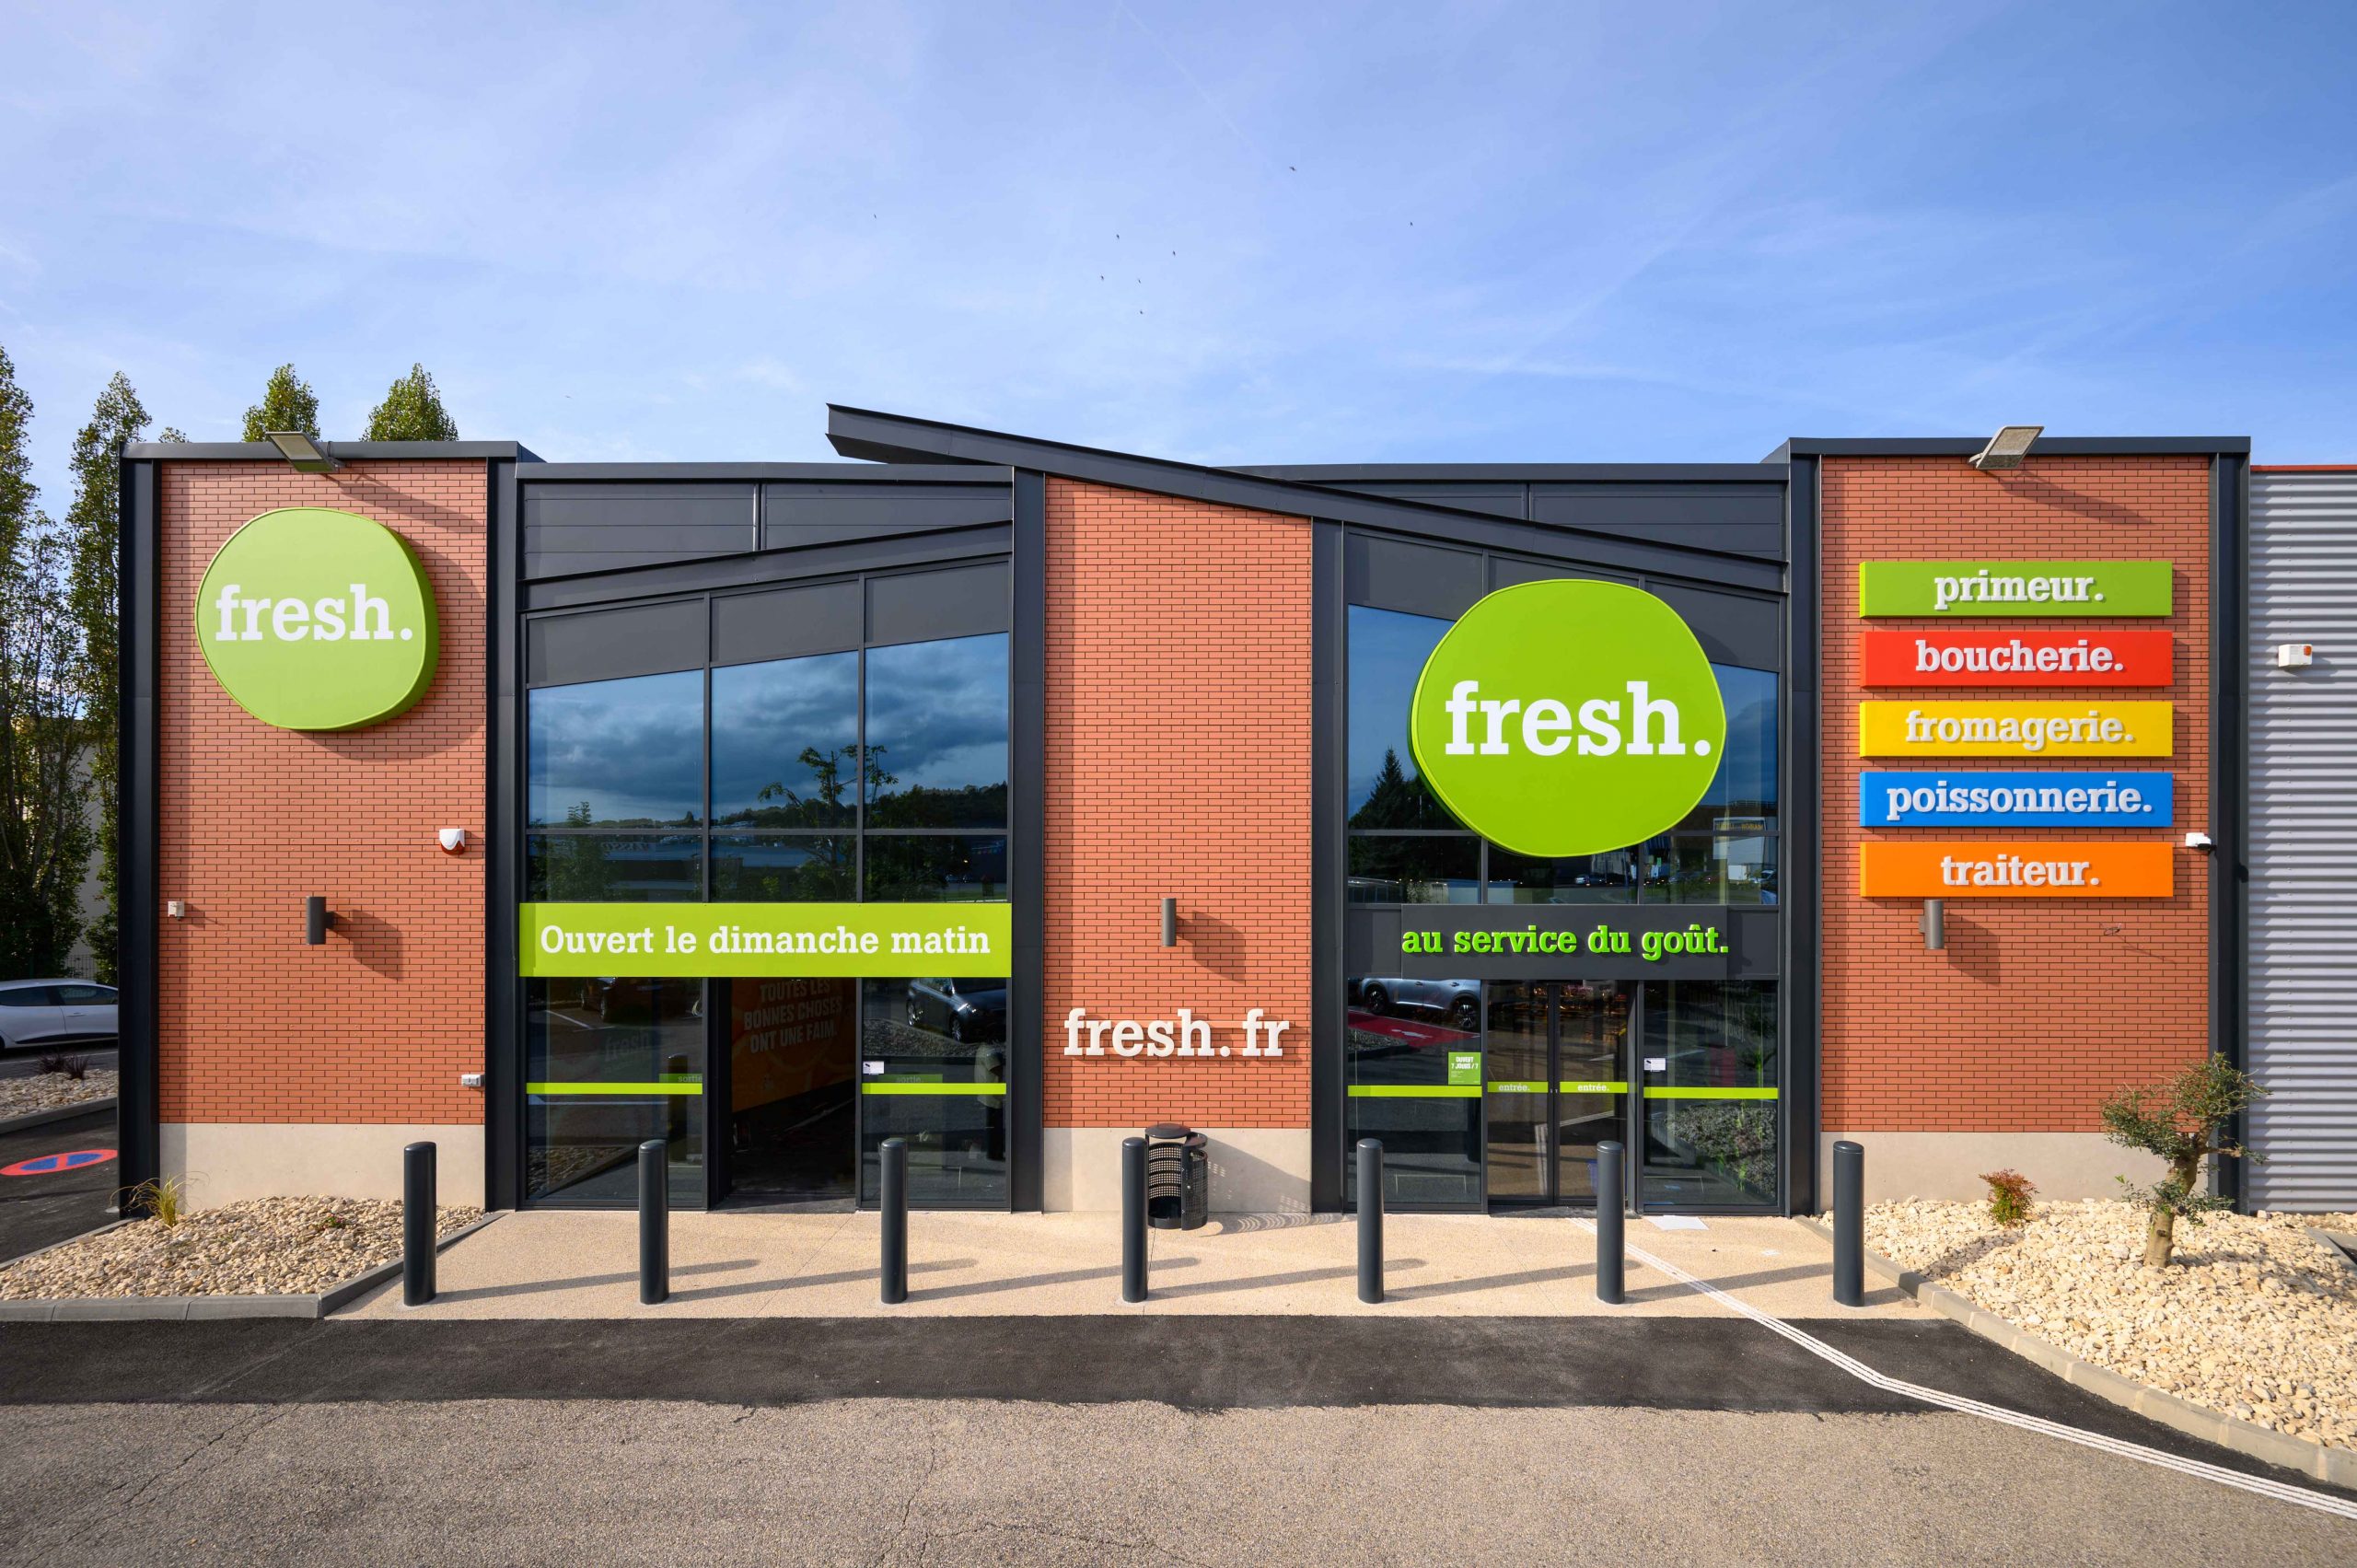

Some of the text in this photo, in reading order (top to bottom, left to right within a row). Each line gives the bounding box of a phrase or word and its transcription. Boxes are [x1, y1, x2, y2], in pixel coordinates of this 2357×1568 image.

[1934, 569, 2104, 610] primeur.
[215, 584, 412, 641] fresh.
[1915, 639, 2123, 672] boucherie.
[1445, 679, 1712, 757] fresh.
[1905, 709, 2134, 751] fromagerie.
[1887, 780, 2154, 821] poissonnerie.
[1941, 854, 2100, 887] traiteur.
[540, 924, 991, 954] Ouvert le dimanche matin
[1401, 923, 1729, 961] au service du goût.
[760, 979, 830, 1003] TOUTES LES
[743, 996, 842, 1030] BONNES CHOSES
[750, 1030, 777, 1054] ONT
[780, 1026, 804, 1047] UNE
[1063, 1007, 1290, 1057] fresh.fr
[1498, 1084, 1530, 1092] entrée.
[1577, 1084, 1610, 1092] entrée.
